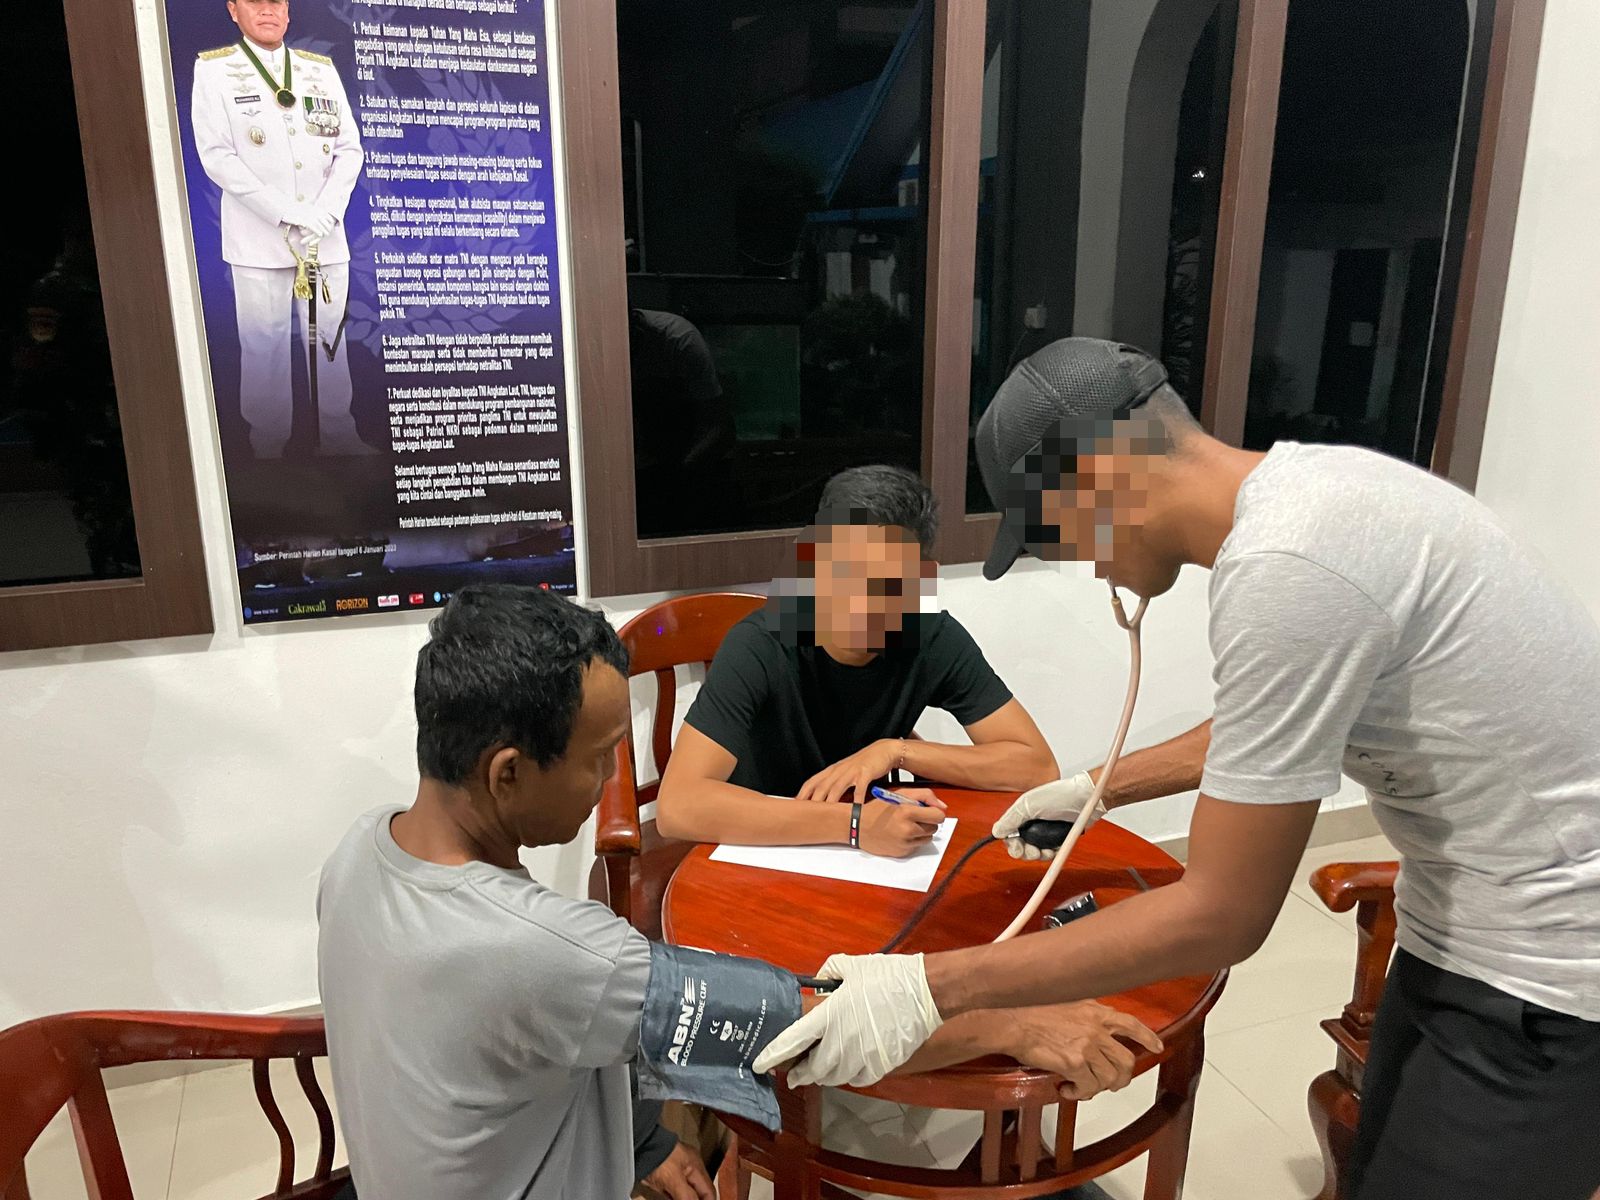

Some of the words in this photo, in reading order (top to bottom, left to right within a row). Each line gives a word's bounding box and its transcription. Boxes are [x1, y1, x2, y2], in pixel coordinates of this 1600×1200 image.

[386, 55, 409, 70] Angkatan
[410, 56, 422, 68] Laut
[389, 112, 413, 127] Angkatan
[414, 113, 425, 124] Laut
[668, 1004, 694, 1065] ABN
[680, 1040, 694, 1066] BLOOD
[690, 1000, 706, 1040] PRESSURE
